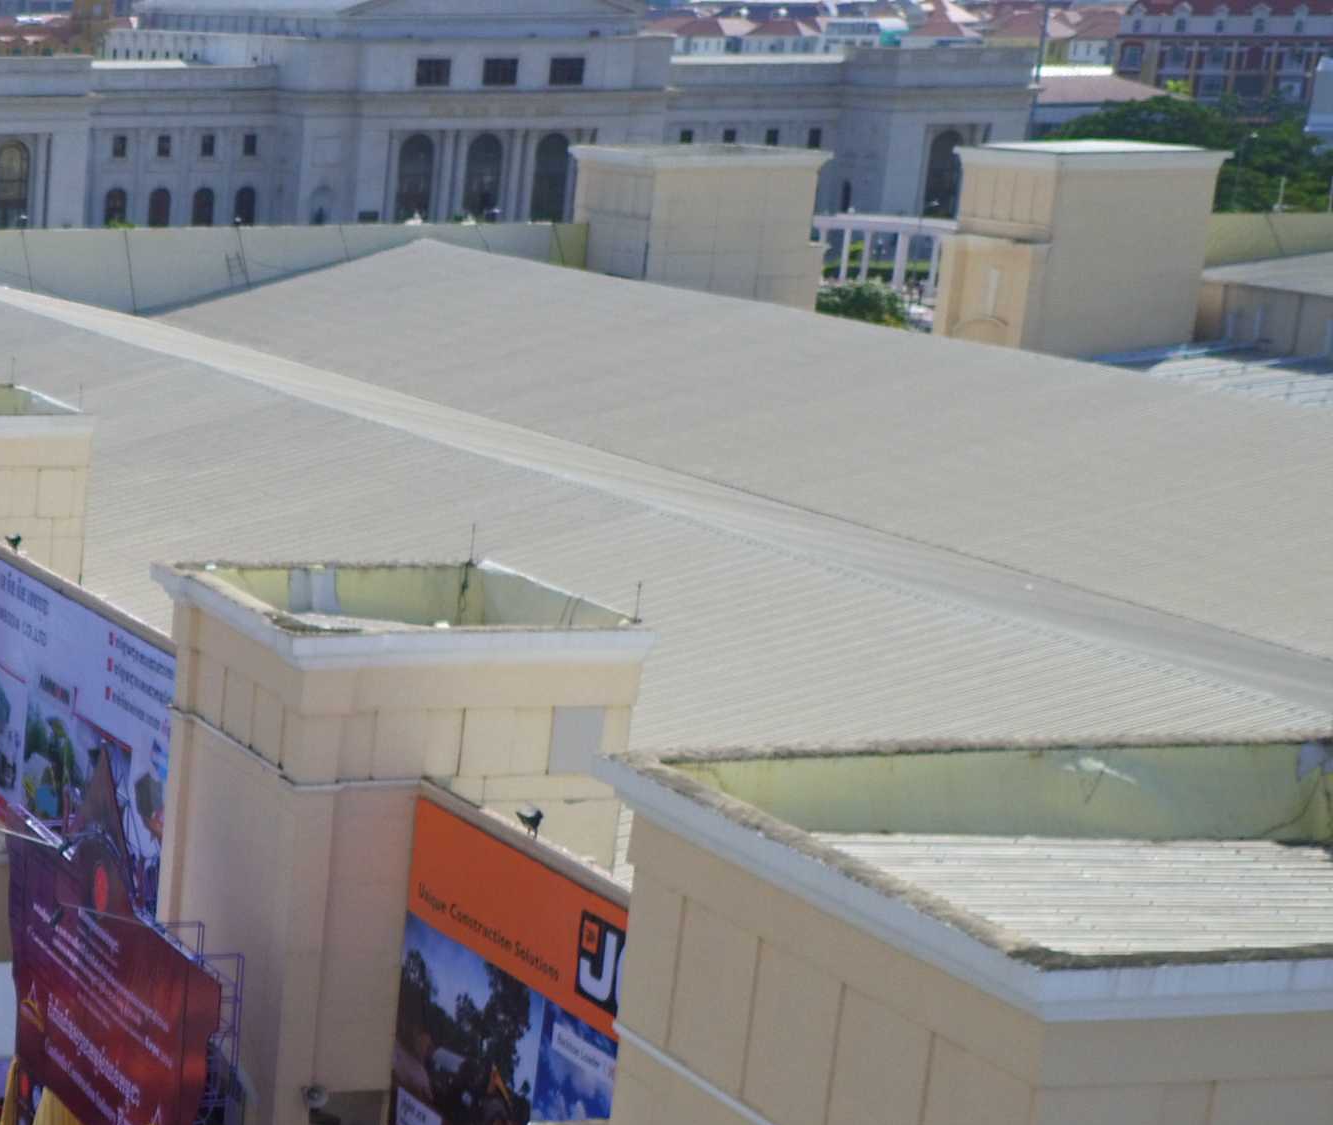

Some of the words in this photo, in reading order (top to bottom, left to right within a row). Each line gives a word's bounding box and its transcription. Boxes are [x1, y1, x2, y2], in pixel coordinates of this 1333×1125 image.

[418, 881, 446, 913] Unique
[449, 902, 513, 951] Construction
[514, 941, 560, 982] Solutions
[579, 931, 627, 1007] J
